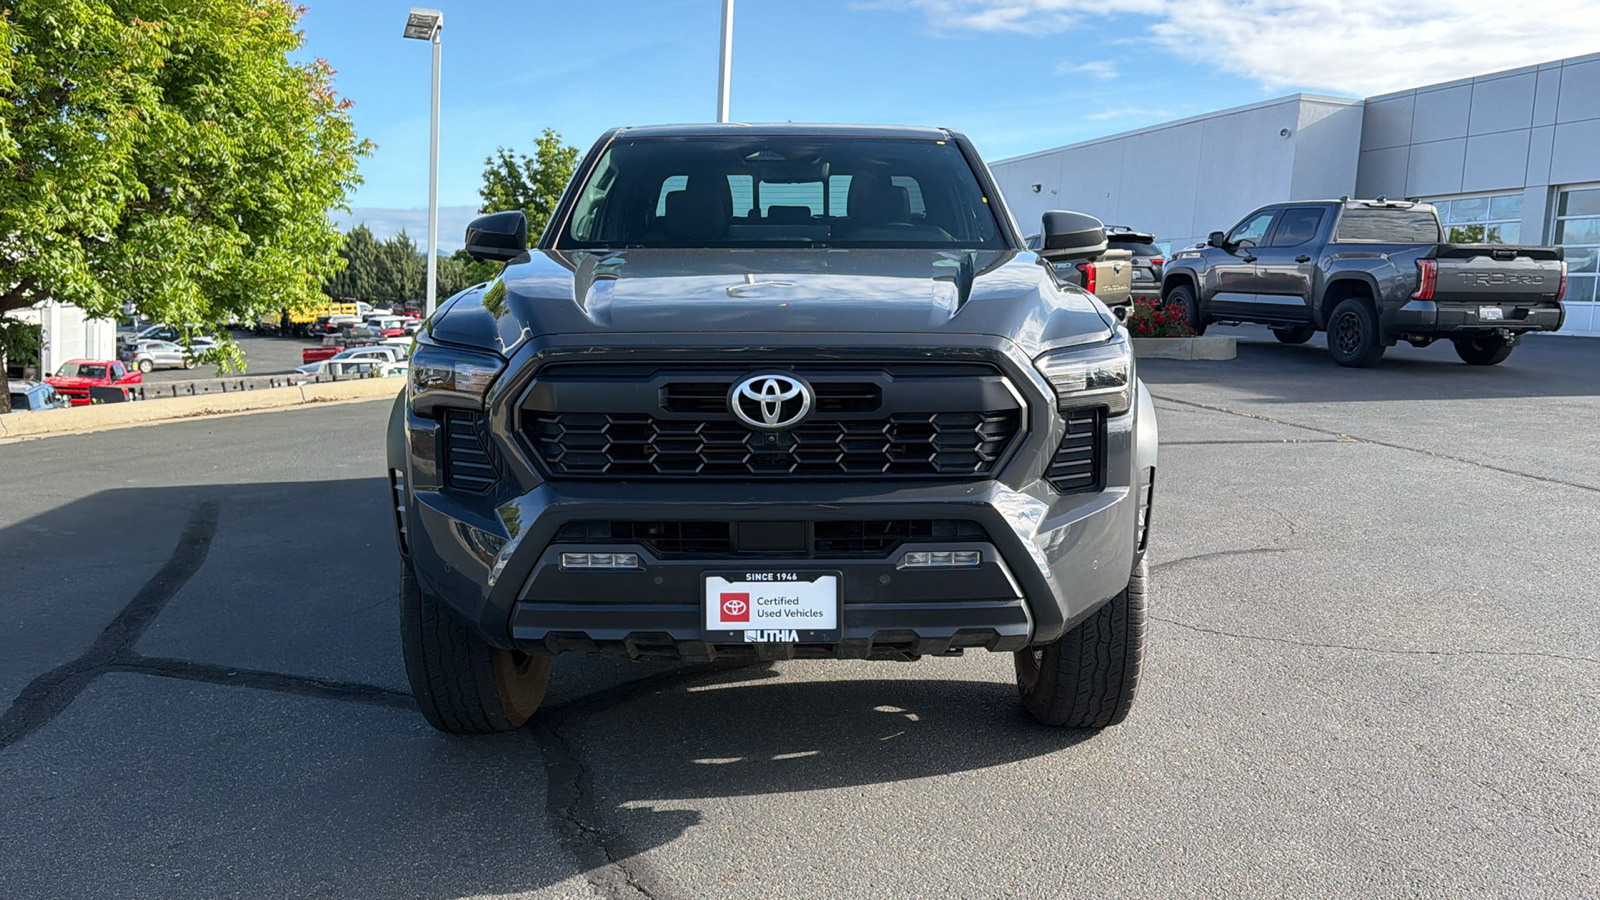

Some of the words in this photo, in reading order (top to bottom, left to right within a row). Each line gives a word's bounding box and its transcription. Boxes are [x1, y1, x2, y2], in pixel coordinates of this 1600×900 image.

[1458, 271, 1506, 286] TRD
[1506, 274, 1544, 285] PRO
[757, 597, 799, 605] Certified
[757, 609, 781, 617] Used
[784, 609, 823, 617] Vehicles
[757, 630, 799, 642] LITHIA
